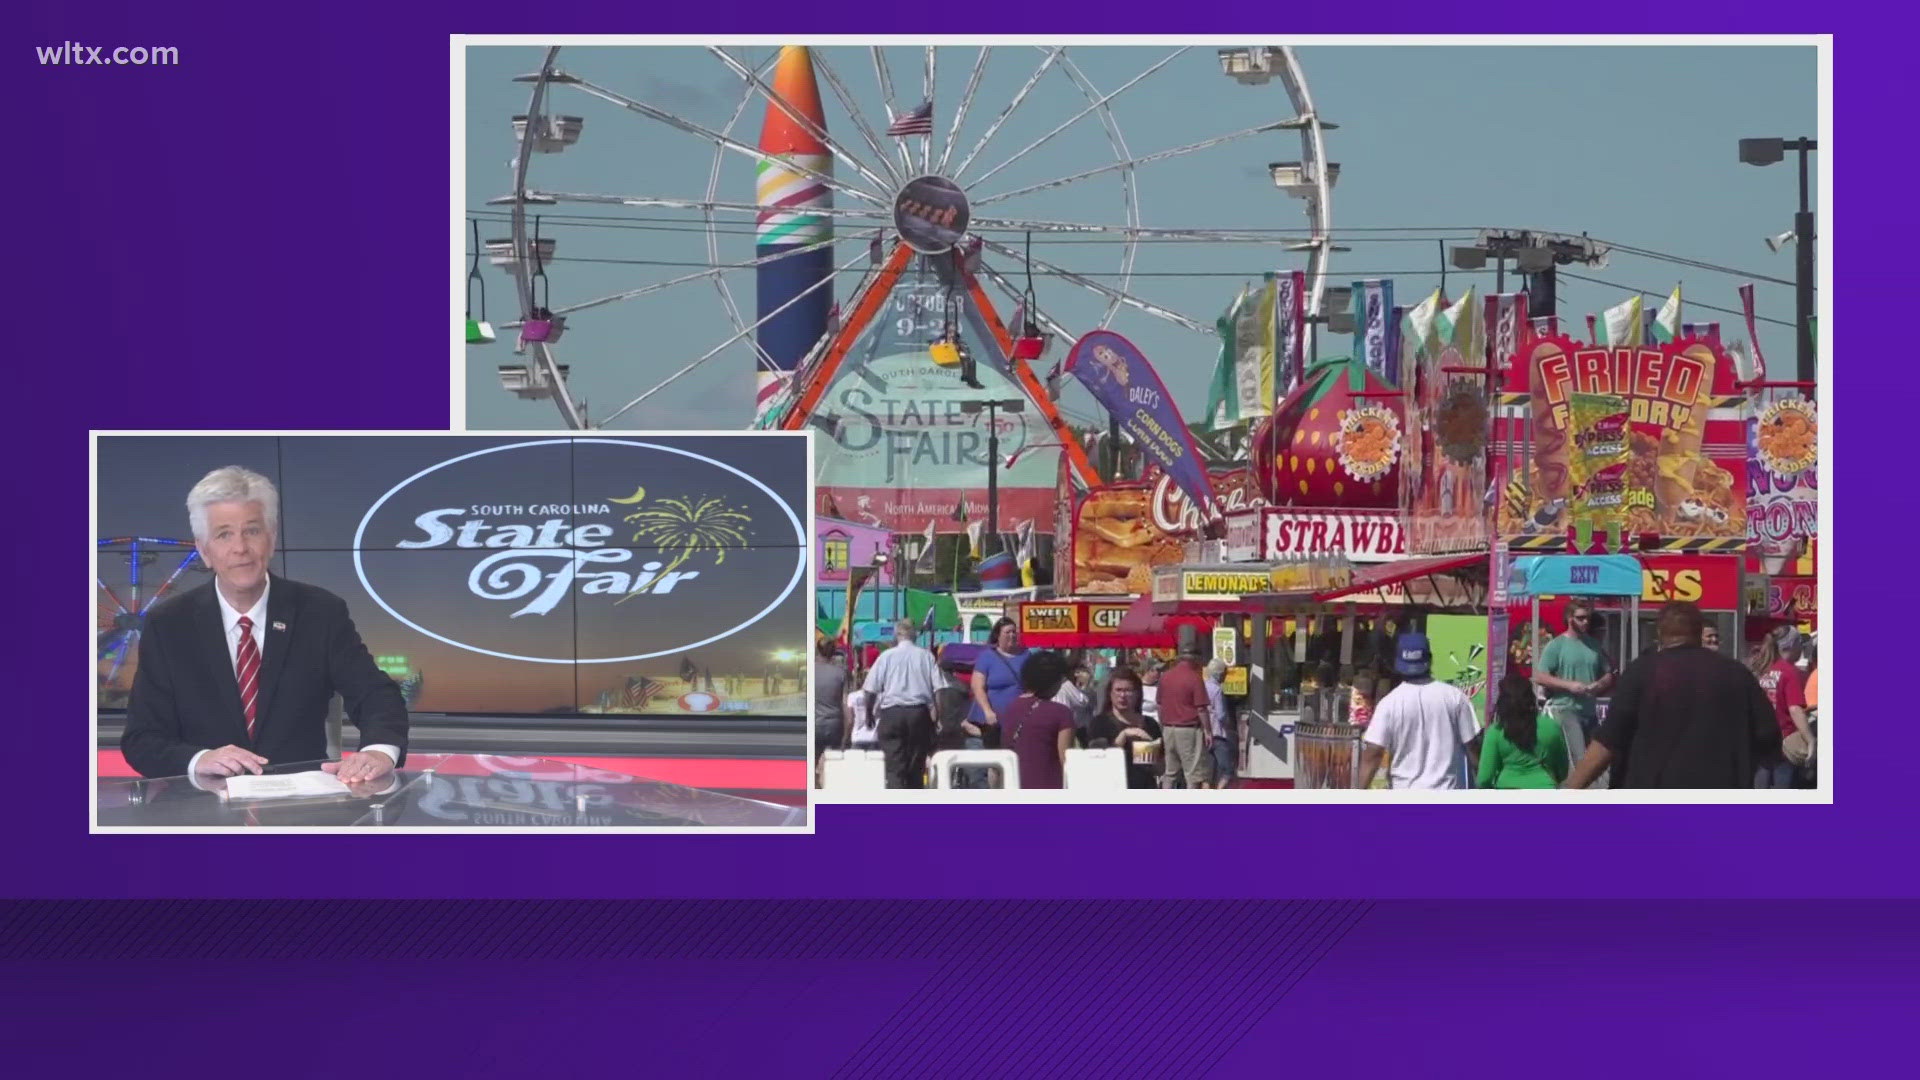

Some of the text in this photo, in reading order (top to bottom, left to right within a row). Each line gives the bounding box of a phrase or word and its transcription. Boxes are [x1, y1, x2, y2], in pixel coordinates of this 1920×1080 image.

[881, 369, 914, 381] OUTH
[1540, 349, 1704, 406] FRIED
[809, 388, 966, 451] STATE
[1552, 398, 1691, 431] FORY
[1158, 430, 1184, 457] DOGS
[884, 430, 991, 483] FAIR
[471, 504, 610, 516] SOUTH CAROLINA
[884, 501, 915, 514] NORTH
[396, 508, 614, 548] State
[468, 547, 699, 618] Fair
[1186, 574, 1270, 595] LEMONADE
[1570, 566, 1599, 584] EXIT
[1026, 614, 1076, 630] TEA
[1029, 608, 1071, 616] SWEET
